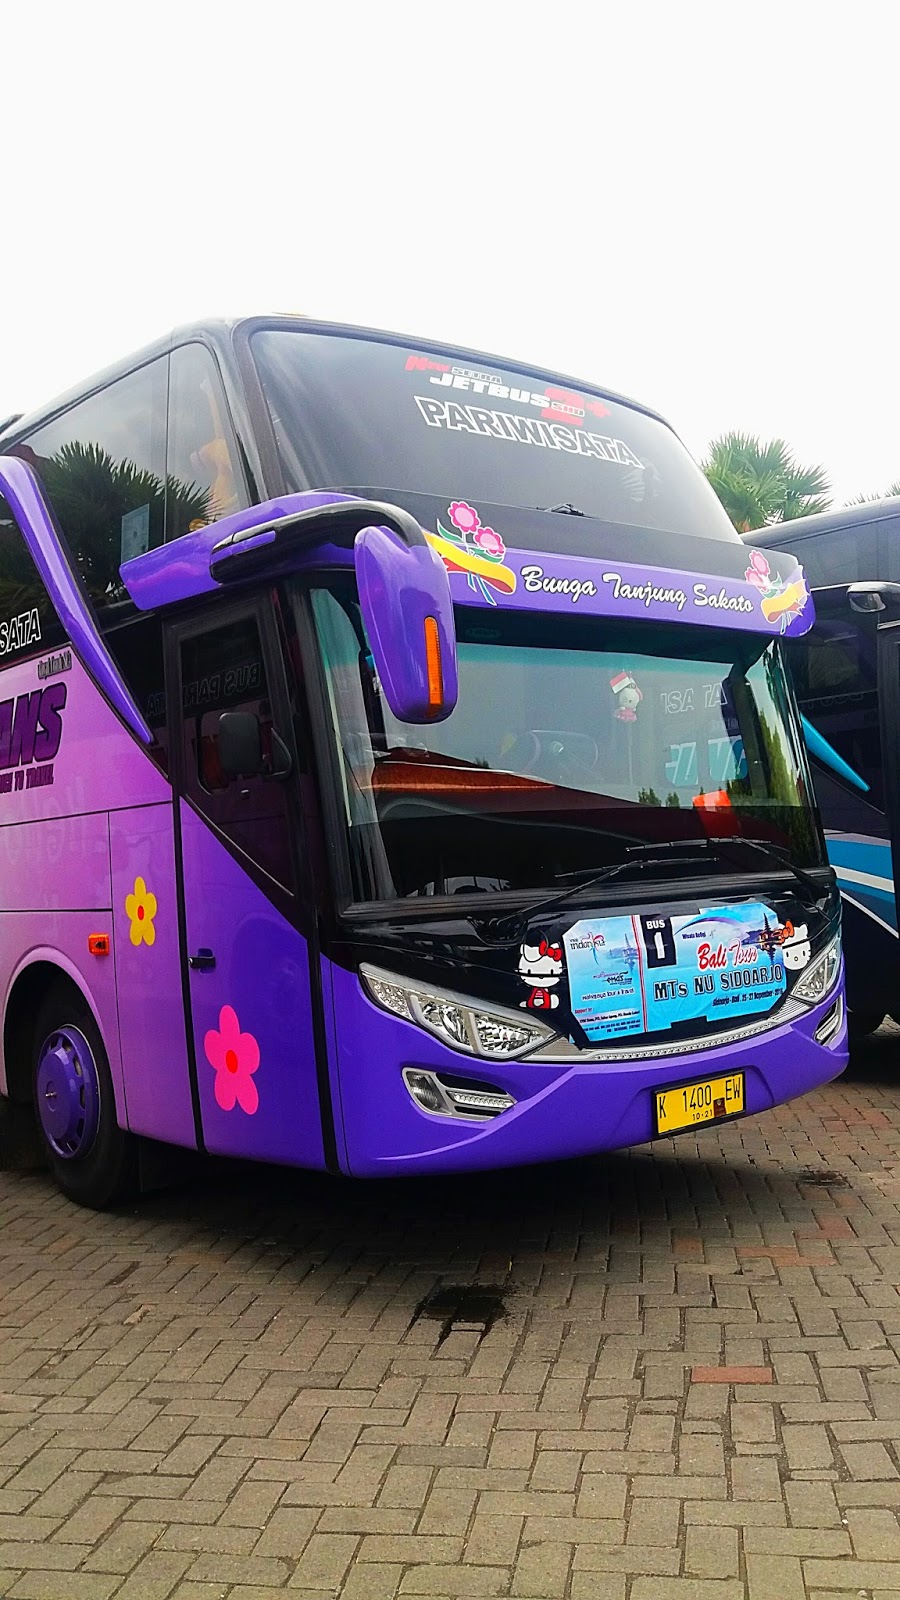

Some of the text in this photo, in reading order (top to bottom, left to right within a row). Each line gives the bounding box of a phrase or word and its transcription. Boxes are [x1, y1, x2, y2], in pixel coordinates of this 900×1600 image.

[429, 373, 550, 408] JETBUS
[413, 395, 645, 469] PARIWISATA
[520, 565, 754, 613] Bunga Tanjung Sakato
[646, 919, 666, 930] BUS
[697, 942, 758, 970] Bali Tour
[653, 963, 783, 1002] MTs NU SIDOARJO
[659, 1077, 740, 1119] K 1400 EW
